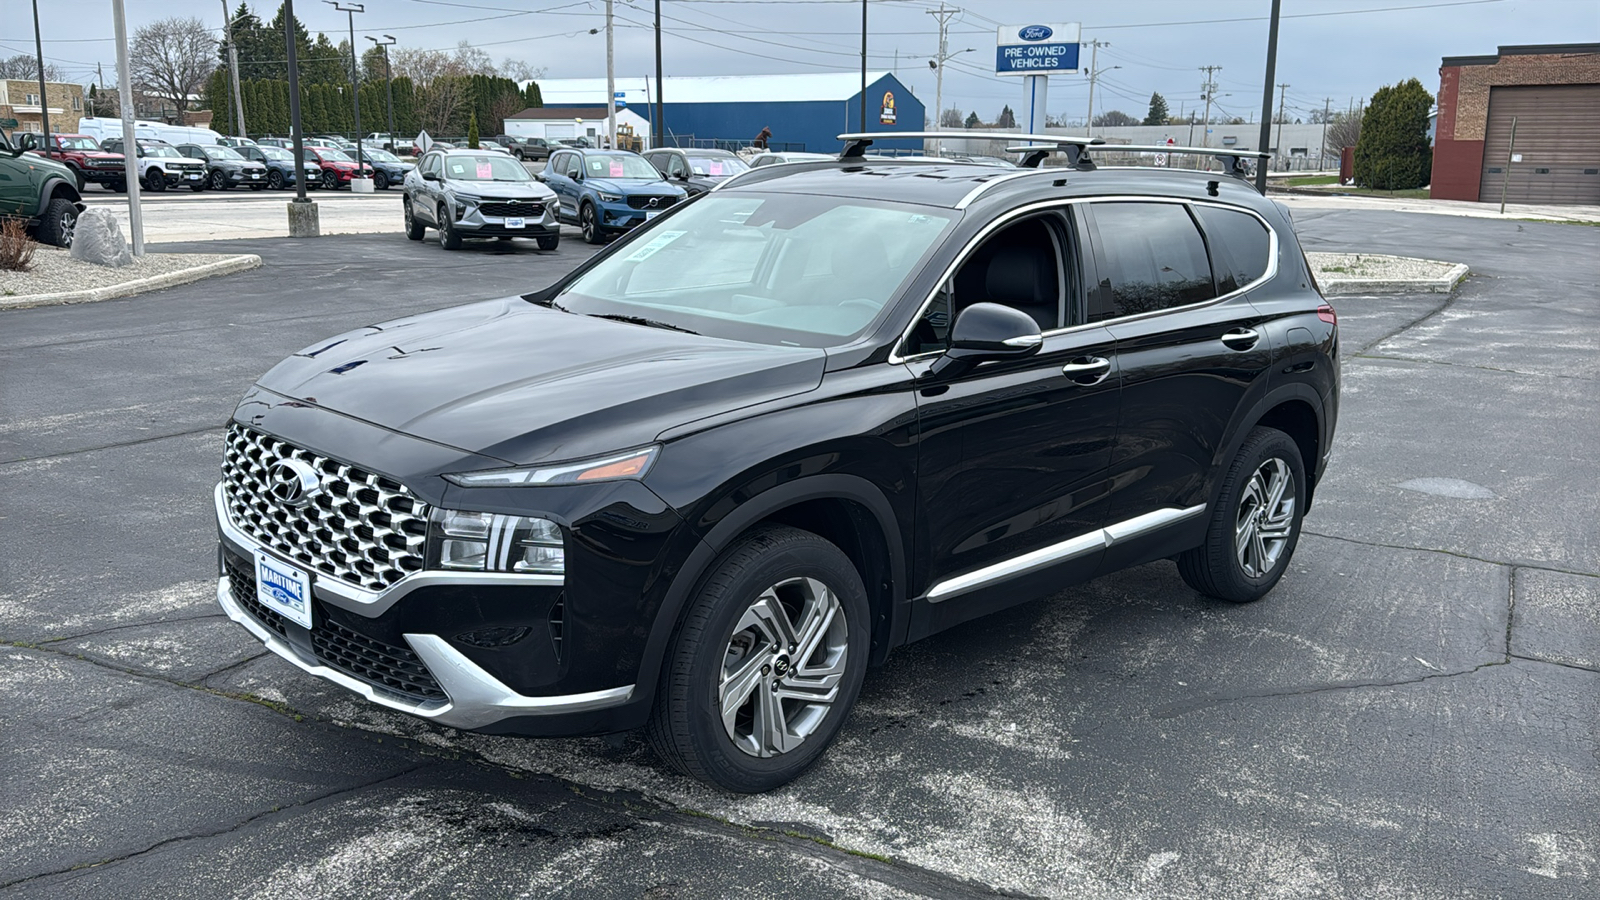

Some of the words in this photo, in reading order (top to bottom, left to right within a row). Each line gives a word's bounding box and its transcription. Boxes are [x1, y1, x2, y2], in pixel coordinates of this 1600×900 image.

[1024, 28, 1044, 39] Ford
[1004, 46, 1066, 58] PRE-OWNED
[1010, 57, 1059, 68] VEHICLES
[261, 565, 302, 600] MARITIME
